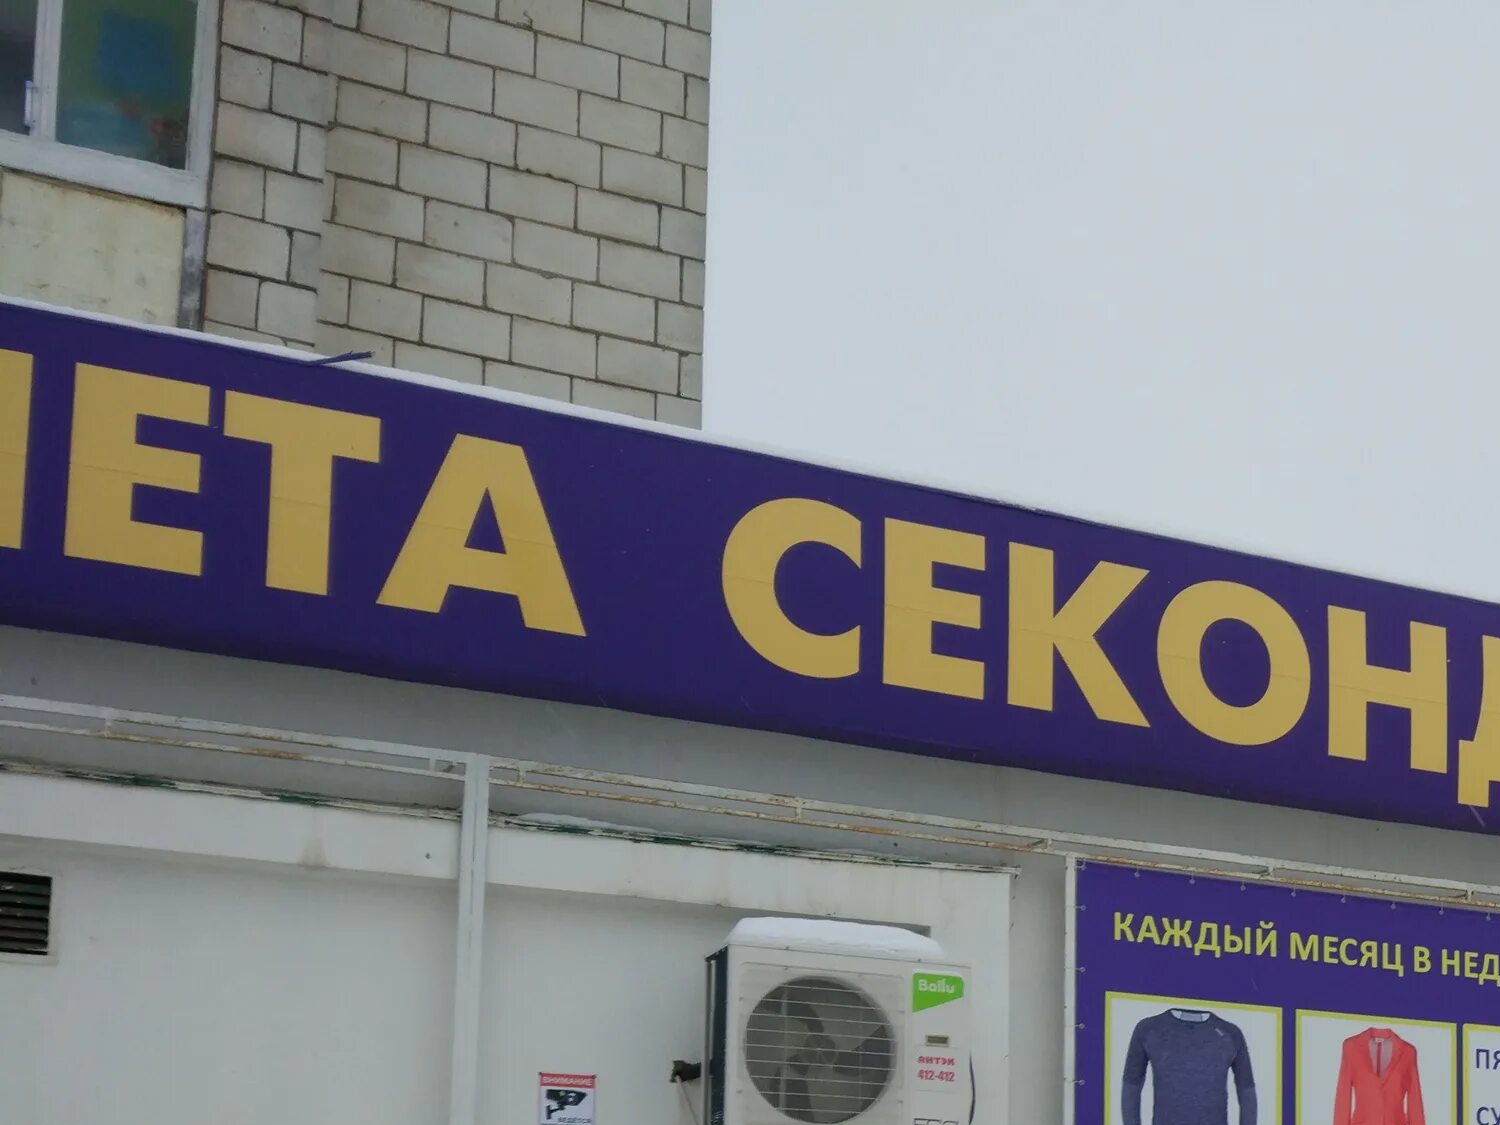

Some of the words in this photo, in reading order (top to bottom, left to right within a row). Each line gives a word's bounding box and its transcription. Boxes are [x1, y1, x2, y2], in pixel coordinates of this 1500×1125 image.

[0, 349, 587, 637] ЕТА
[1114, 912, 1277, 957] КАЖДЫЙ
[1290, 932, 1404, 976] МЕСЯЦ
[1414, 946, 1432, 973] В
[917, 978, 956, 995] Ballu
